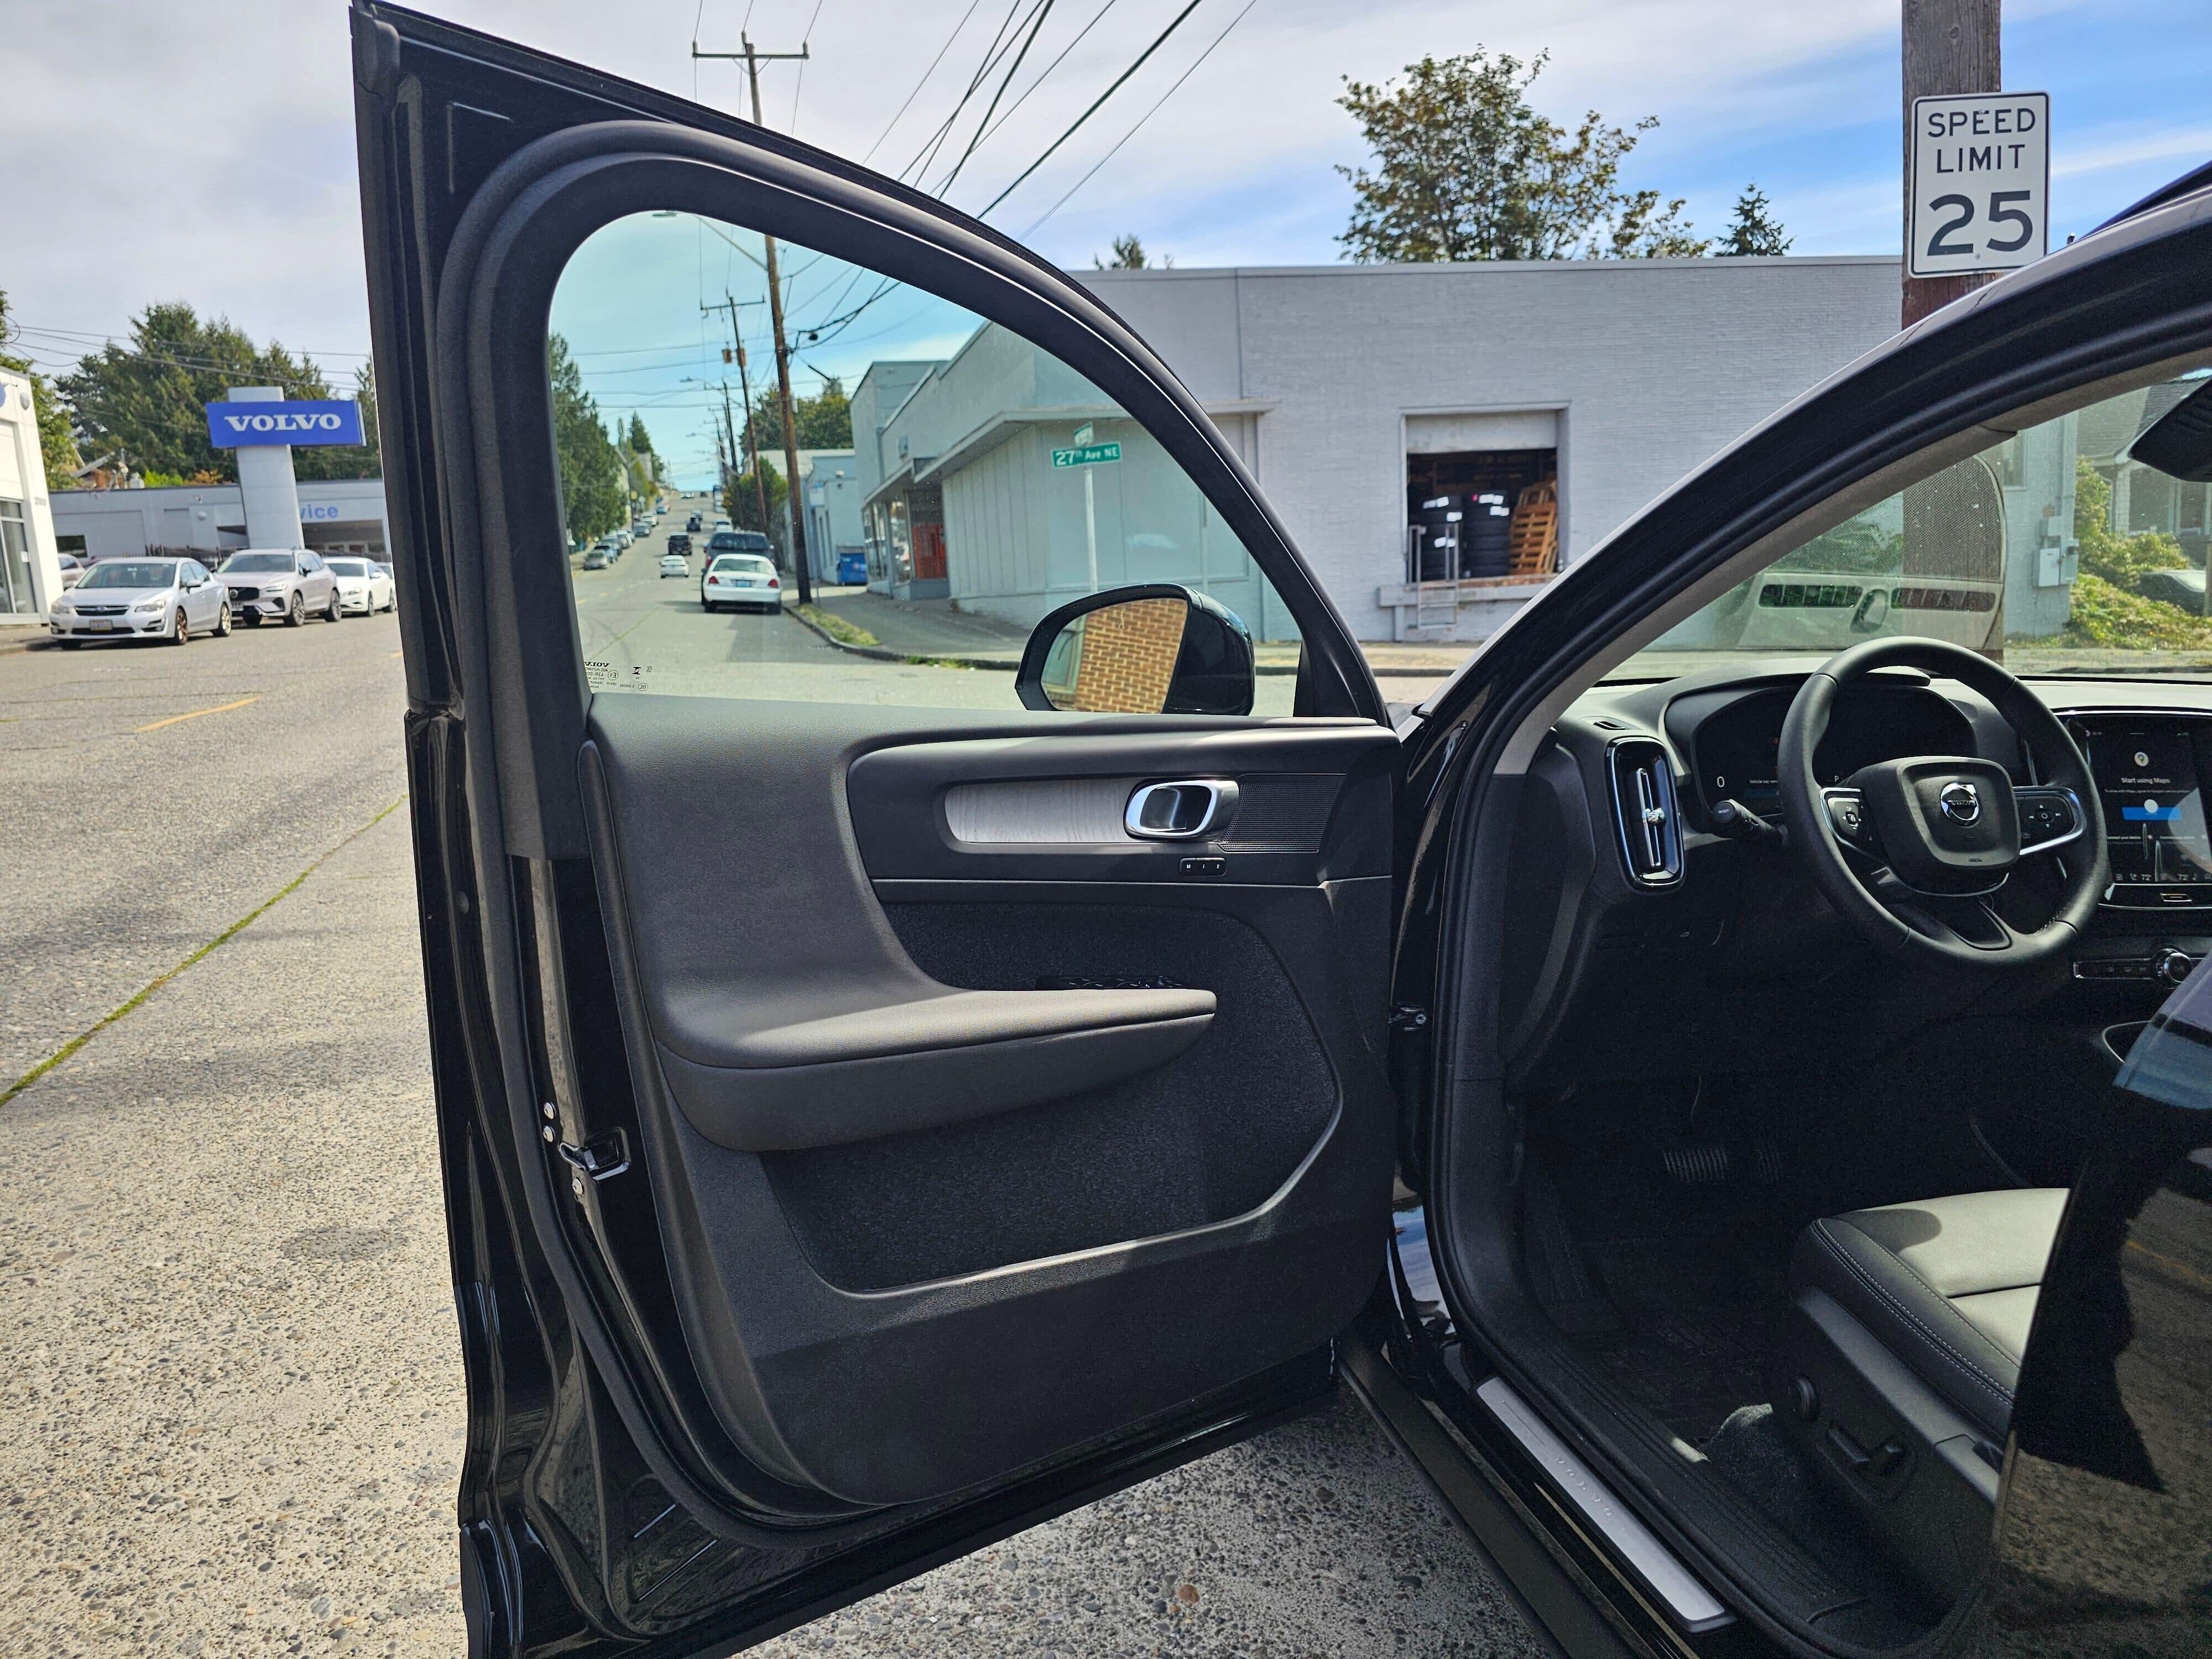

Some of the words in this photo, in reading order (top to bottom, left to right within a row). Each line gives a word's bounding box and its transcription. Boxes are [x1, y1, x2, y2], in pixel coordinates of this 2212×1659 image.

[1927, 108, 2035, 138] SPEED
[1937, 144, 2026, 173] LIMIT
[1927, 190, 2033, 256] 25
[224, 413, 342, 431] VOLVO
[1085, 451, 1101, 459] Ave
[1104, 447, 1119, 457] NE
[1717, 776, 1725, 787] 0
